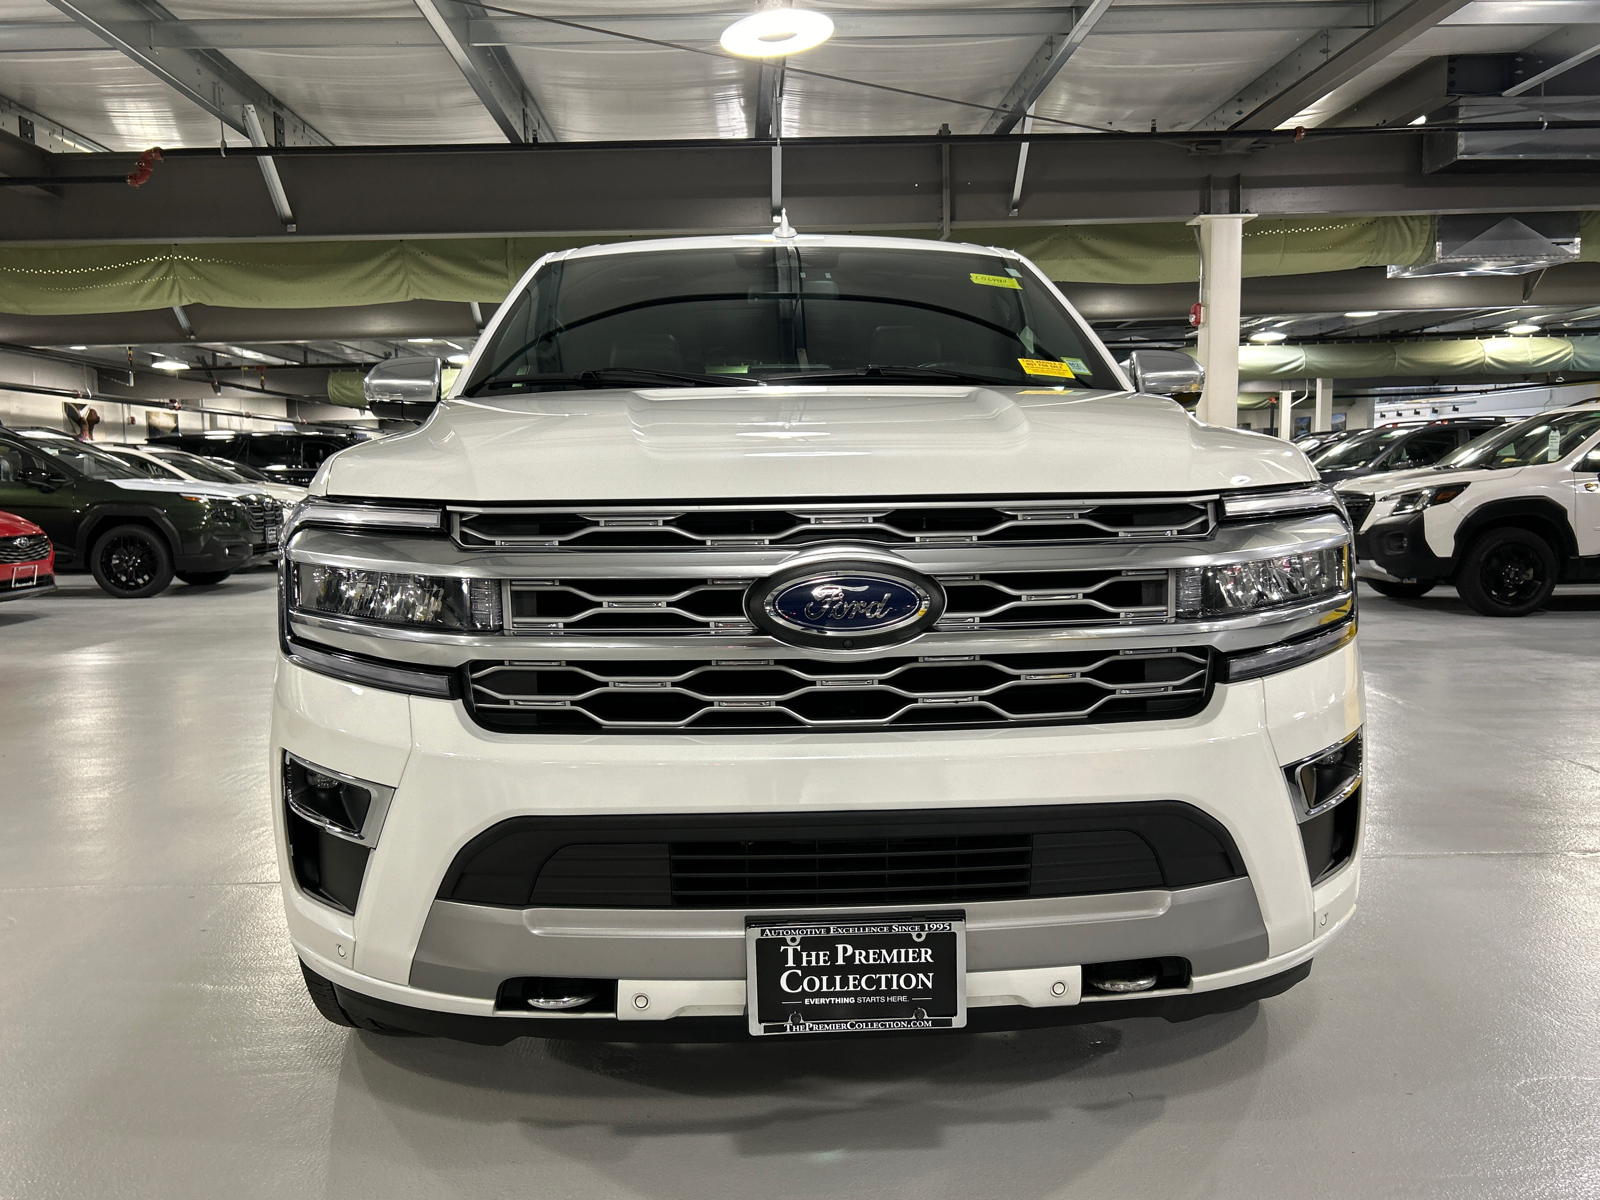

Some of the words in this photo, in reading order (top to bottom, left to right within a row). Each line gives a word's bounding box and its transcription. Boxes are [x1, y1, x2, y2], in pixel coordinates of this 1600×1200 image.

[804, 584, 892, 620] Ford
[763, 927, 827, 937] AUTOMOTIVE
[830, 926, 890, 935] EXCELLENCE
[892, 924, 921, 933] SINCE
[924, 923, 950, 932] 1995
[780, 945, 831, 967] THE
[834, 944, 934, 965] PREMIER
[779, 969, 934, 993] COLLECTION
[804, 997, 855, 1005] EVERYTHING
[857, 996, 886, 1004] STARTS
[887, 995, 910, 1003] HERE.
